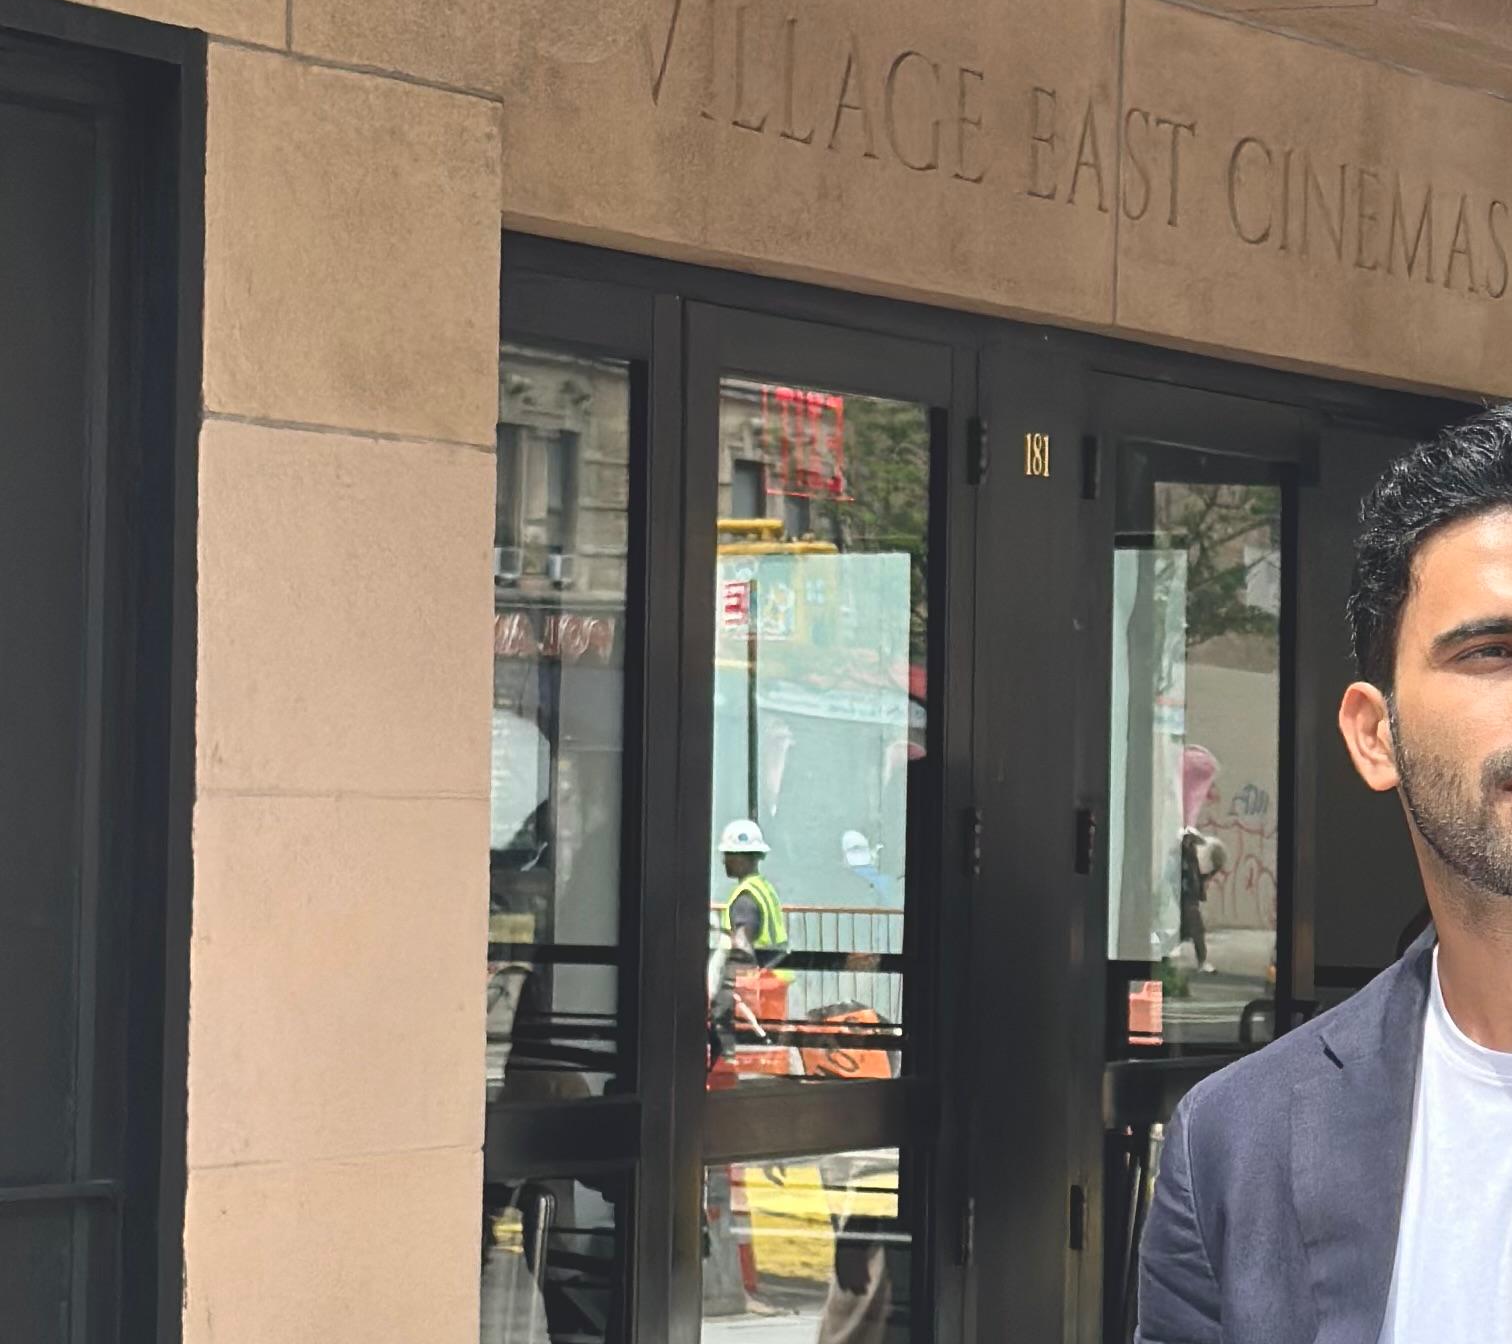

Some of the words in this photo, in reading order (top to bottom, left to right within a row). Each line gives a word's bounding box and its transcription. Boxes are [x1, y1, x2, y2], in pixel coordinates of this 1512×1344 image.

[1026, 86, 1197, 228] EAST
[1228, 136, 1511, 301] CINEMAS
[1024, 432, 1050, 477] 181
